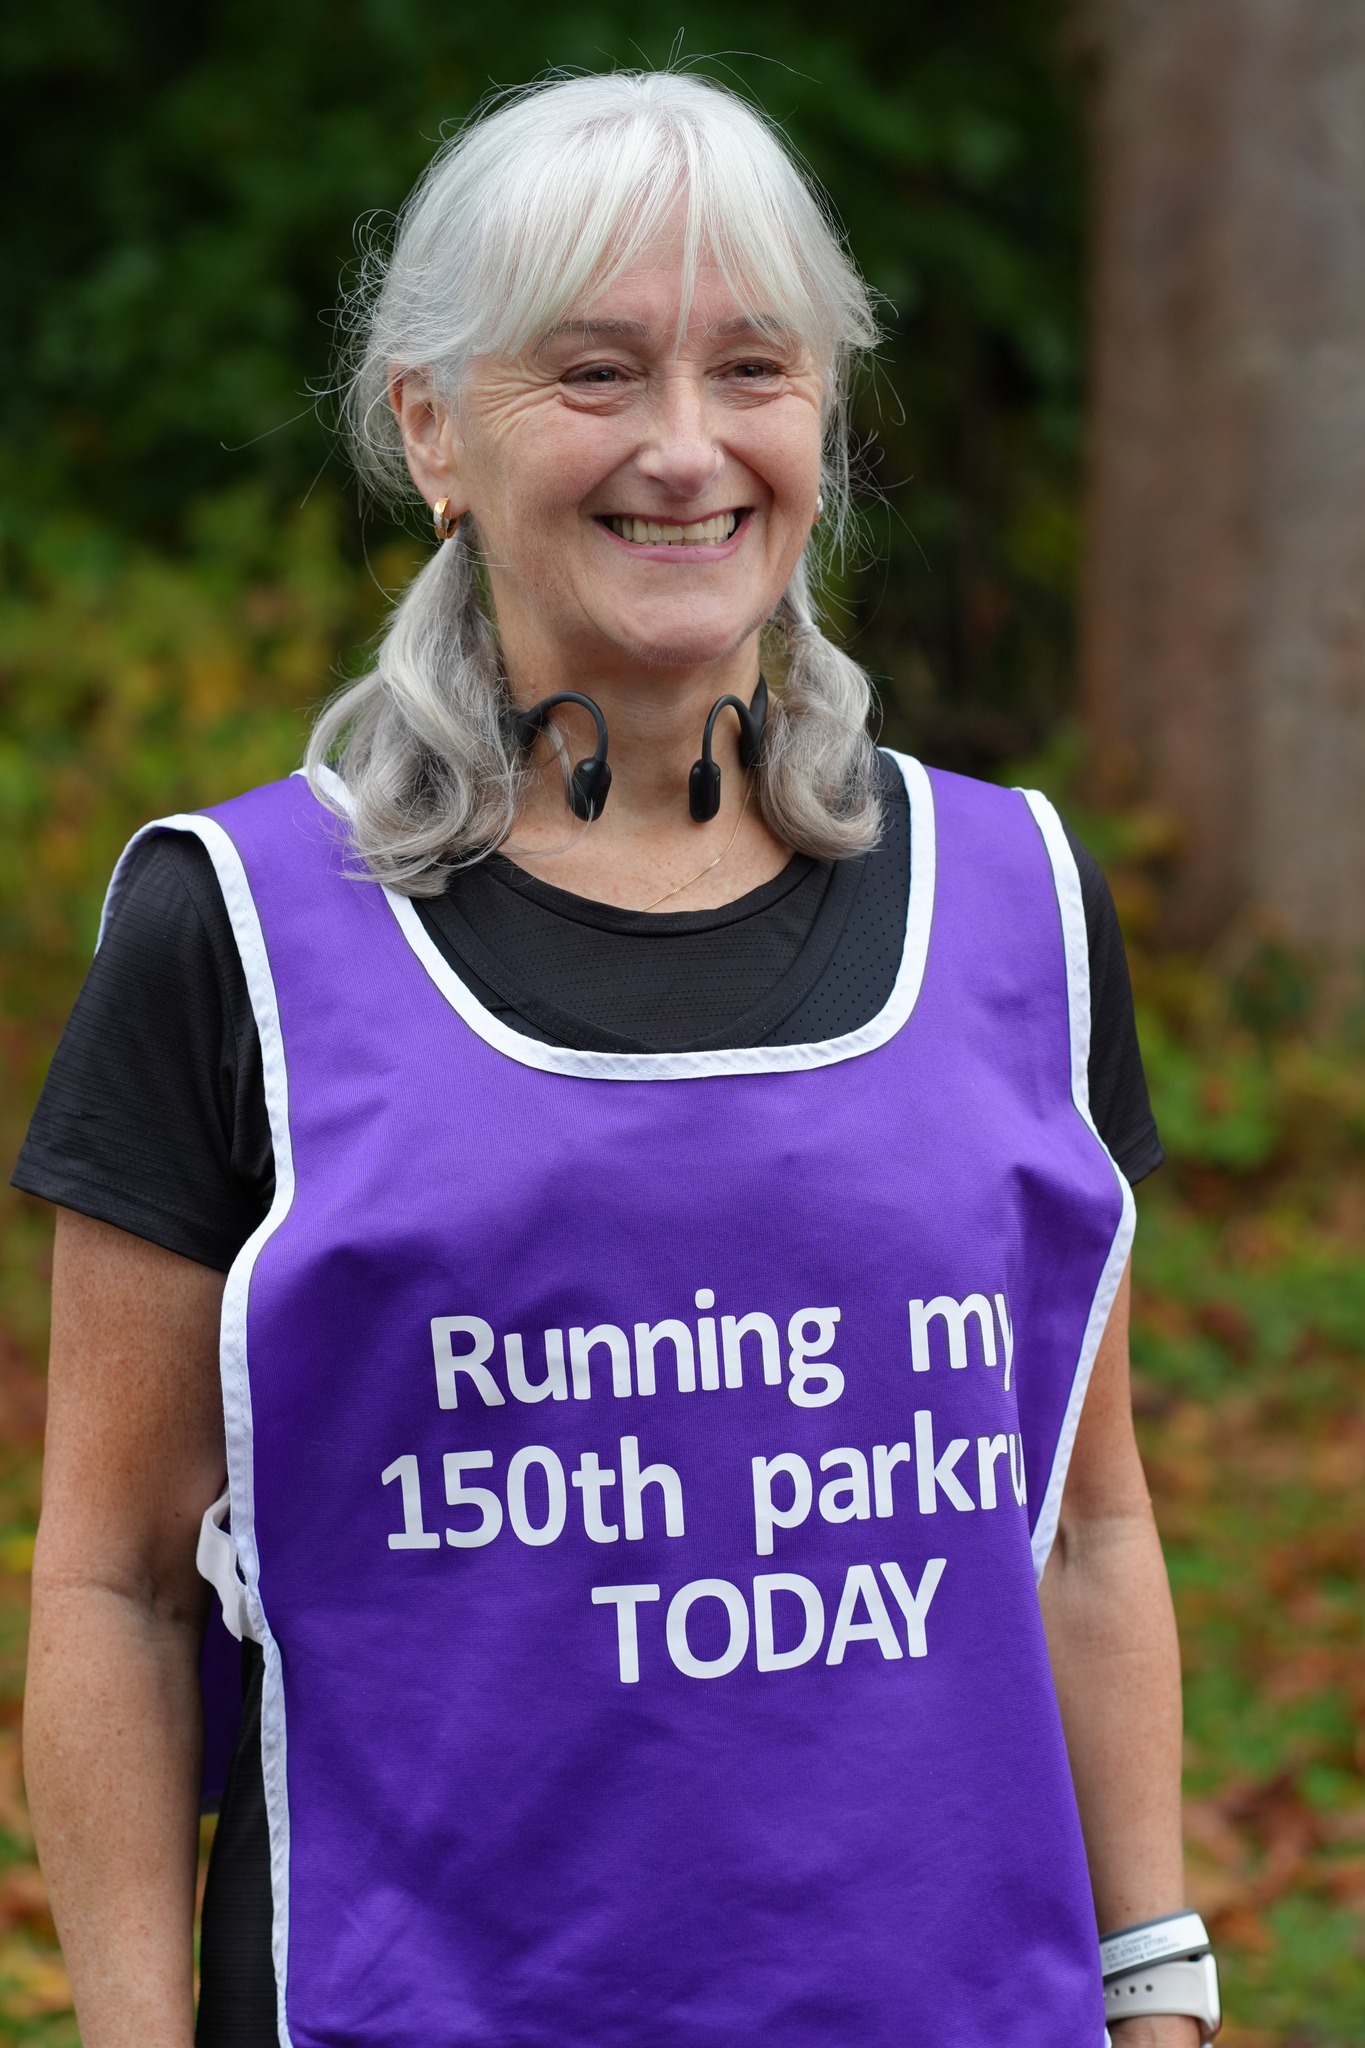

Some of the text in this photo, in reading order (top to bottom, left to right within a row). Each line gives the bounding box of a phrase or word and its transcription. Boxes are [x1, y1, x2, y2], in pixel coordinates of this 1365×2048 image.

[430, 1288, 1014, 1410] Running my
[381, 1409, 1027, 1556] 150th parkru
[591, 1557, 947, 1684] TODAY
